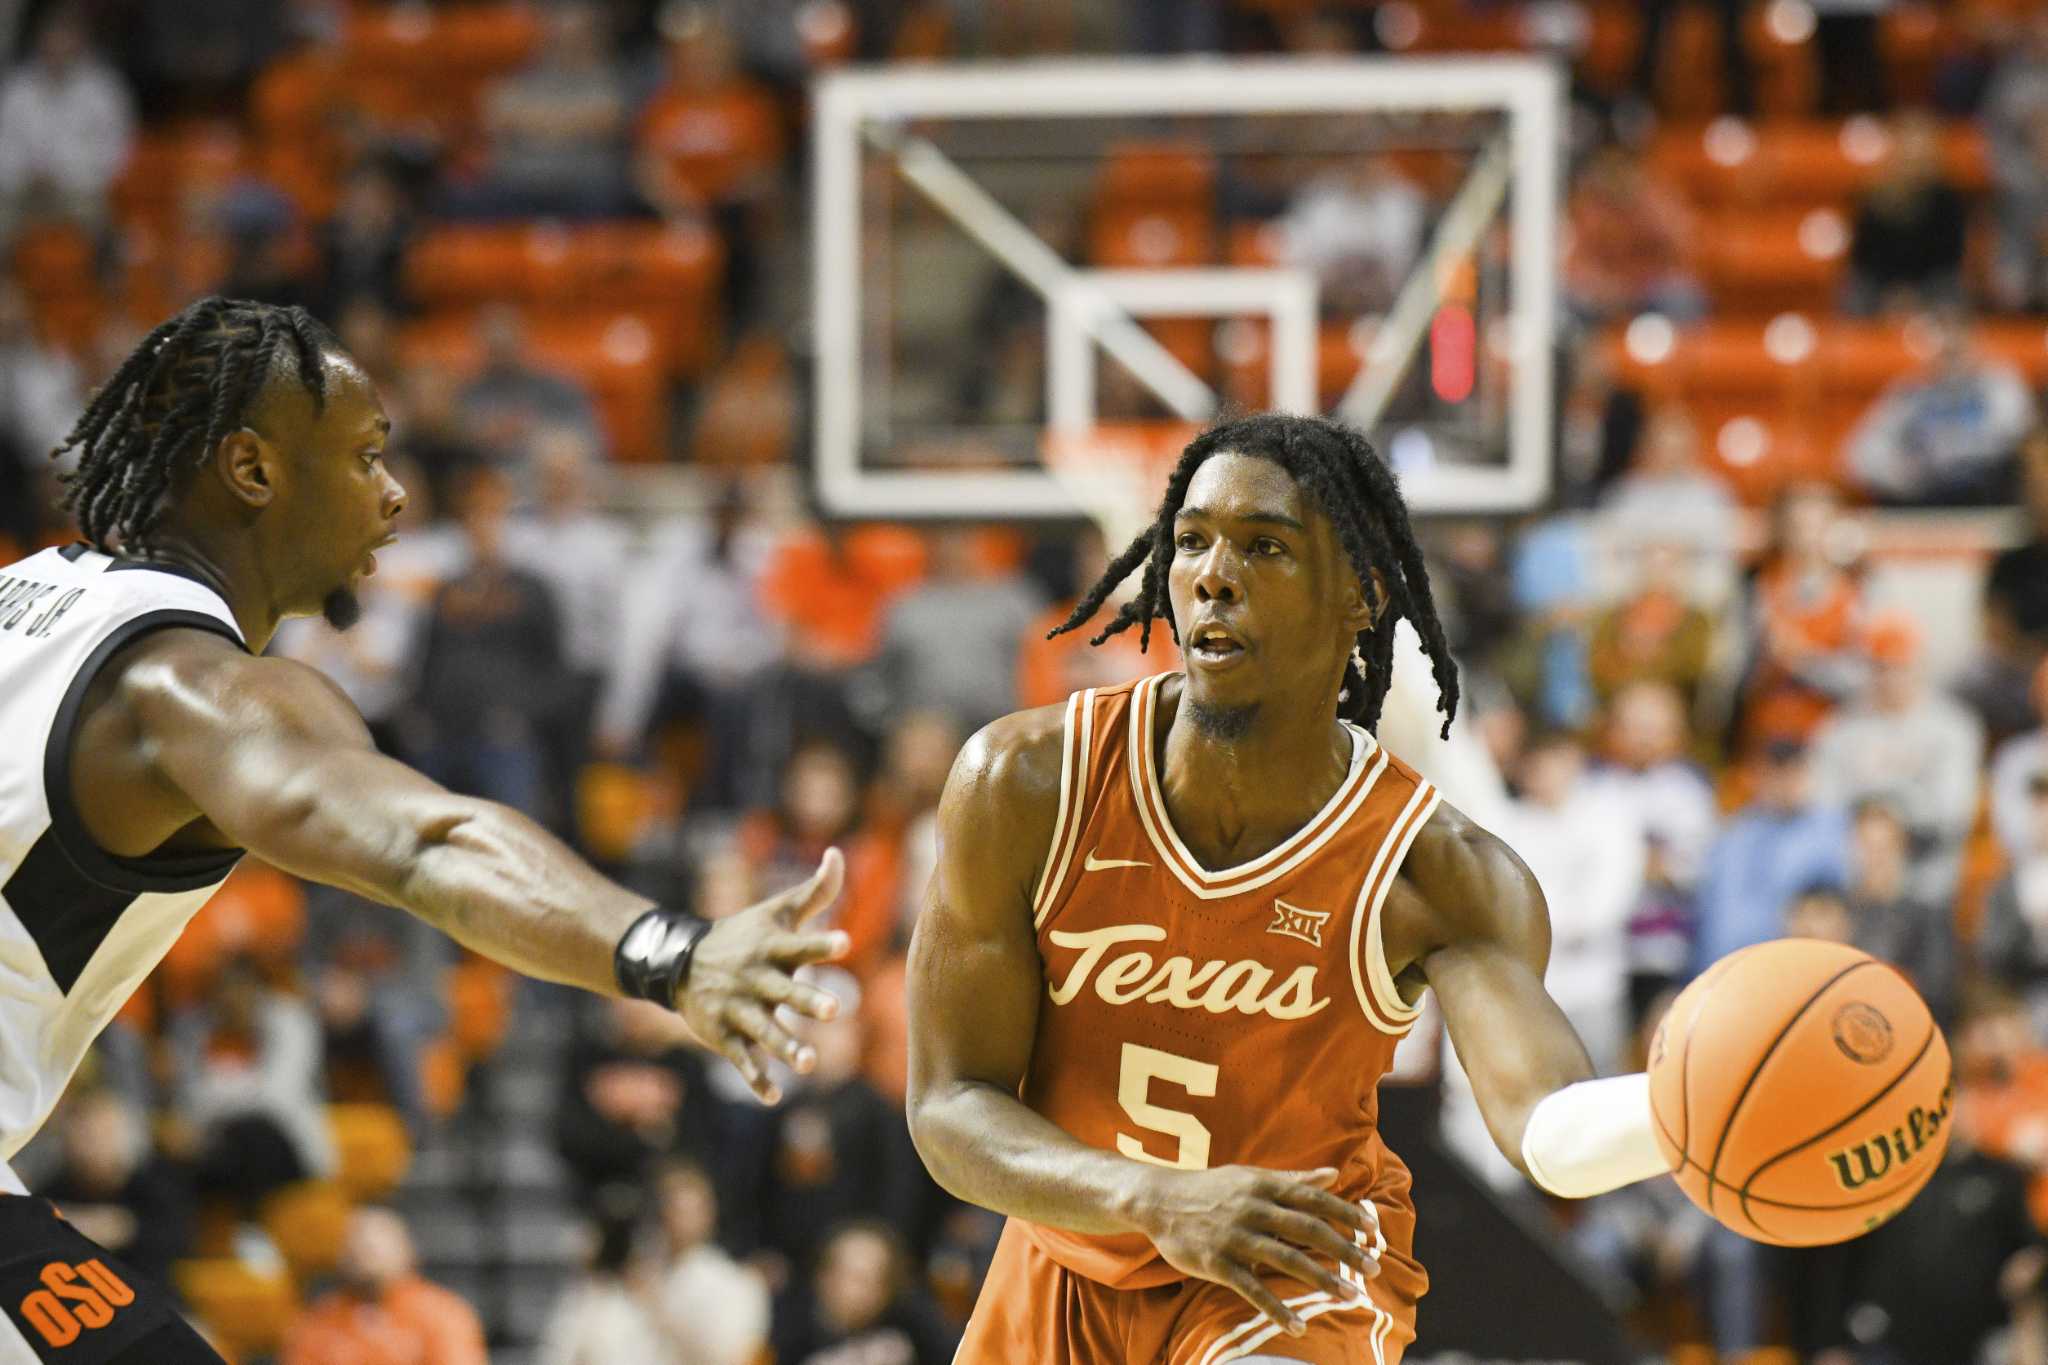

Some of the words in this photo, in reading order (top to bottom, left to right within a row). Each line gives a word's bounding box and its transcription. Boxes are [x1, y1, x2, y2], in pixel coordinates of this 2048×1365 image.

[1049, 924, 1331, 1020] Texas
[1116, 1042, 1219, 1170] 5
[20, 1259, 135, 1347] OSU
